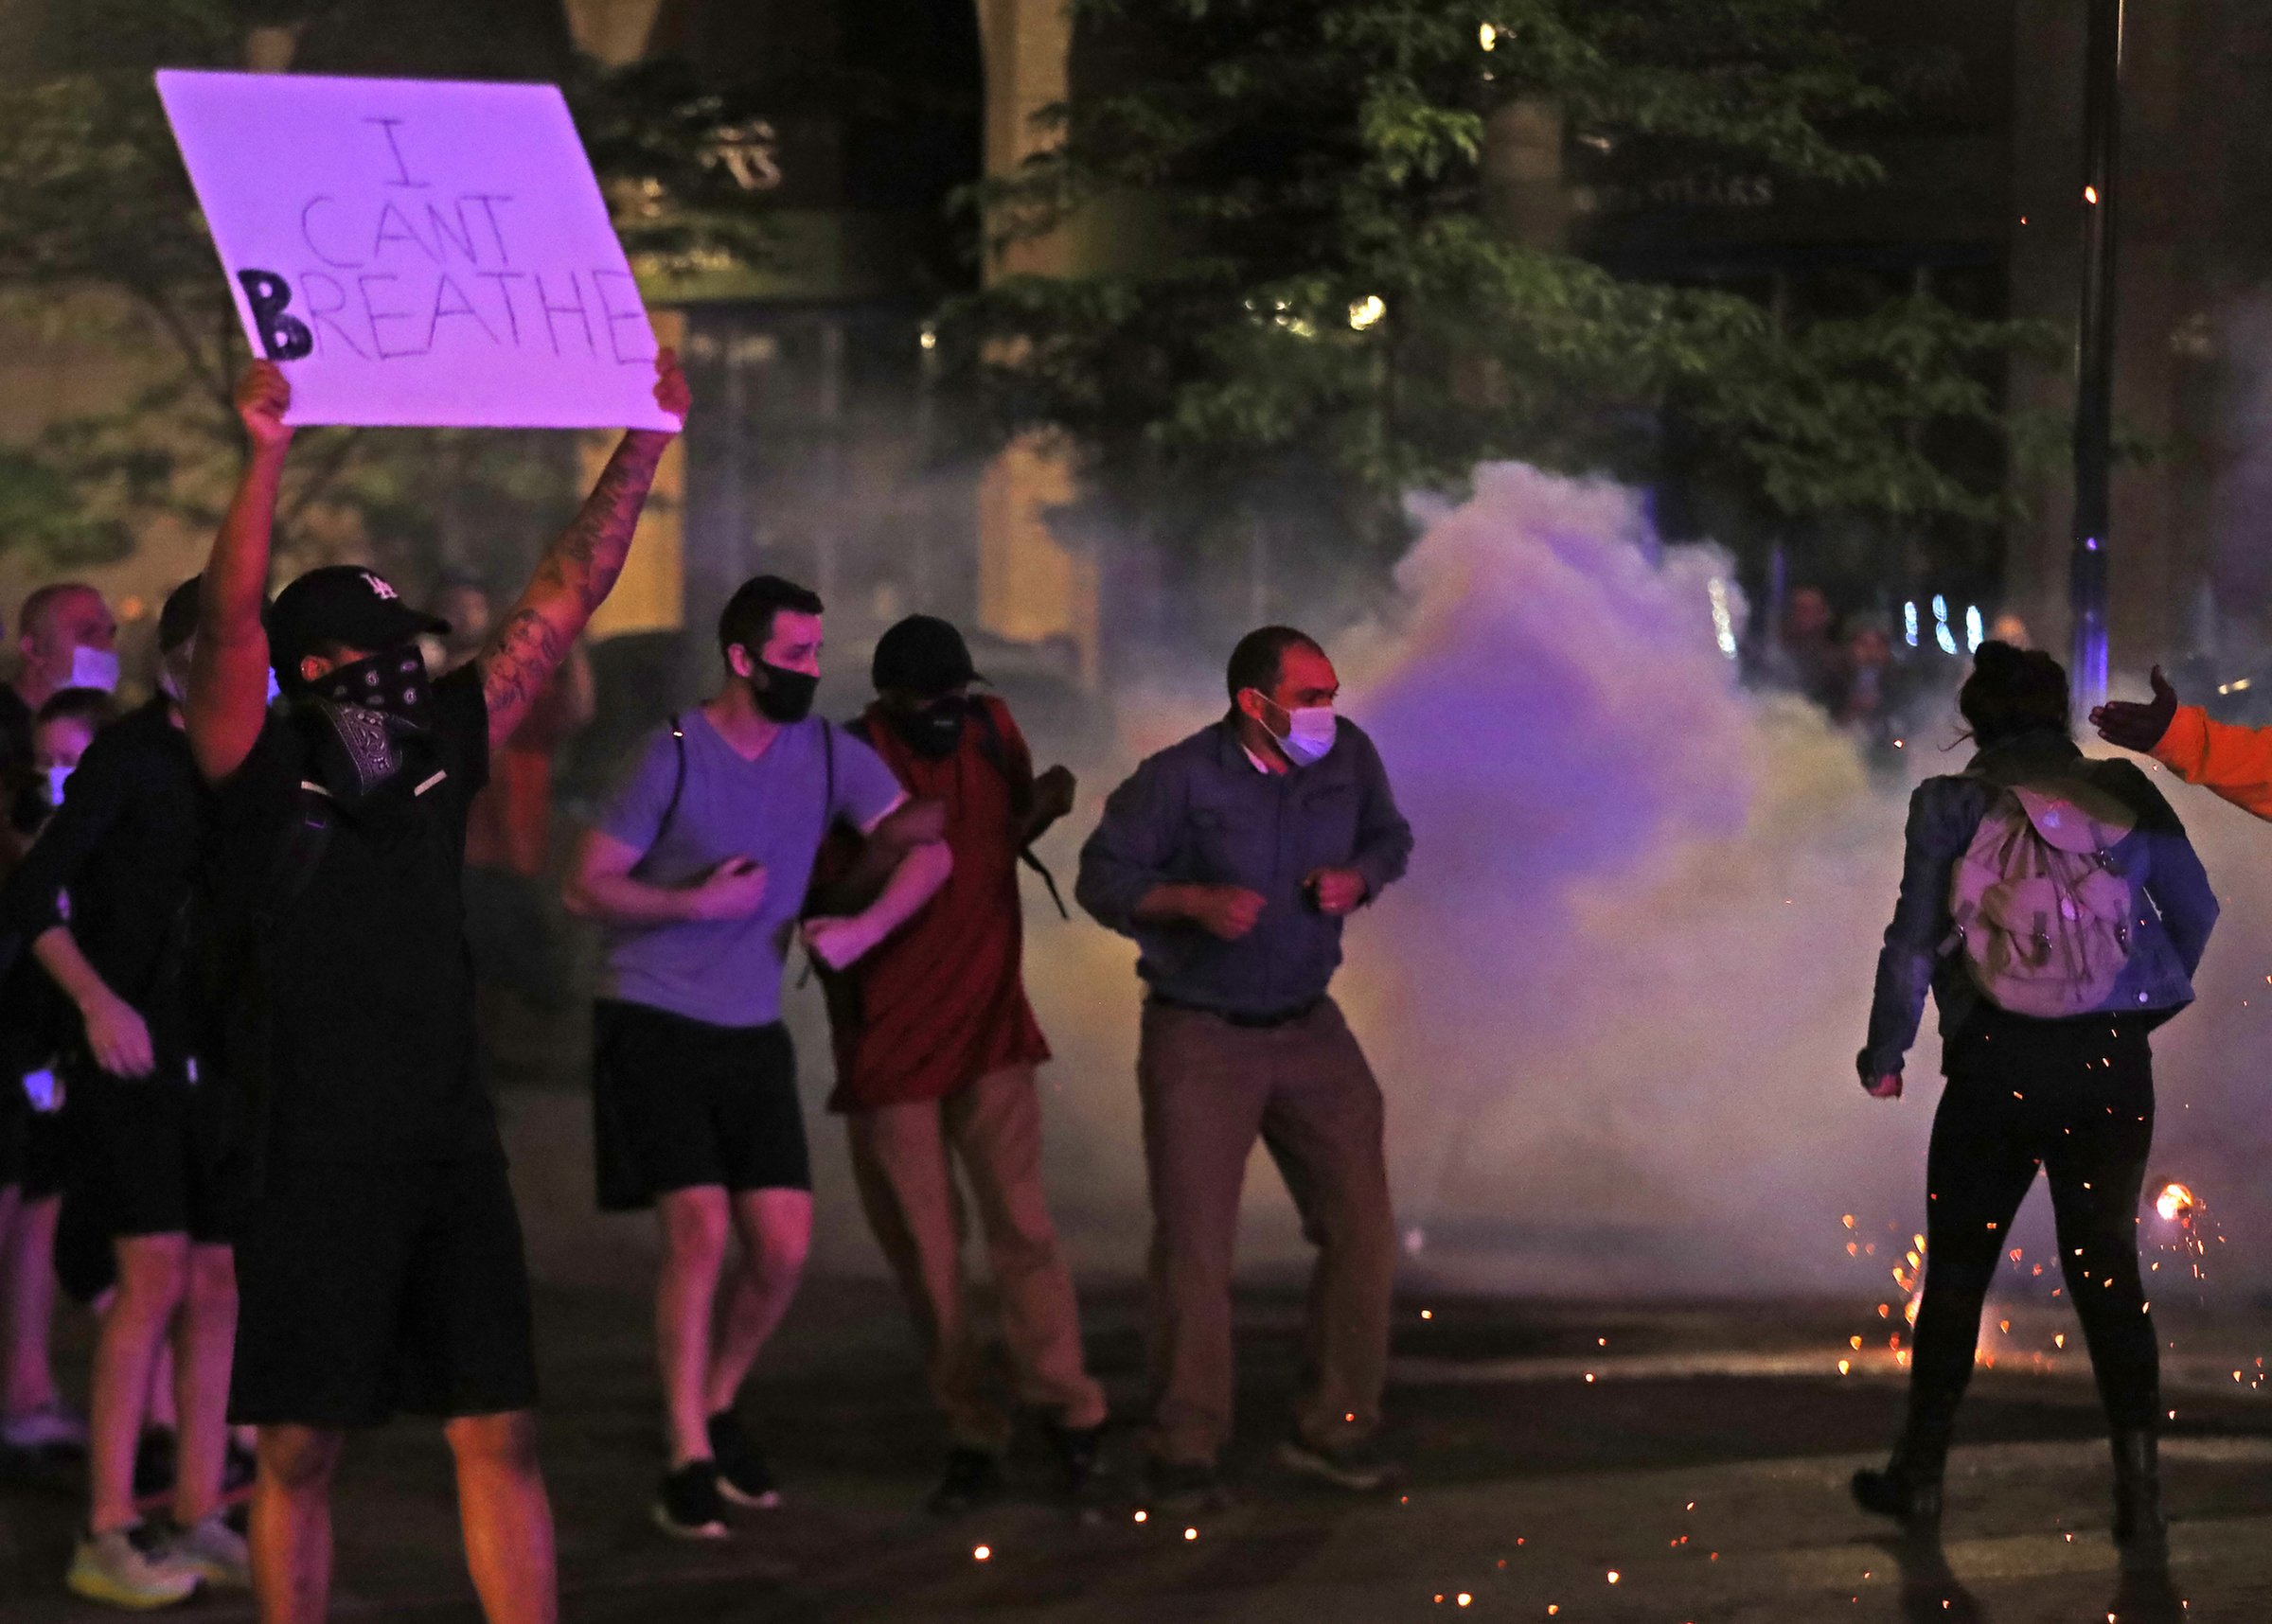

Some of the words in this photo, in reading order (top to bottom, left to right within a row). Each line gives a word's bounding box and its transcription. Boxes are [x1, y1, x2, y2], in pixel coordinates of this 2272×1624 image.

[364, 117, 430, 189] I
[301, 193, 514, 270] CANT
[236, 268, 657, 365] BREATHE
